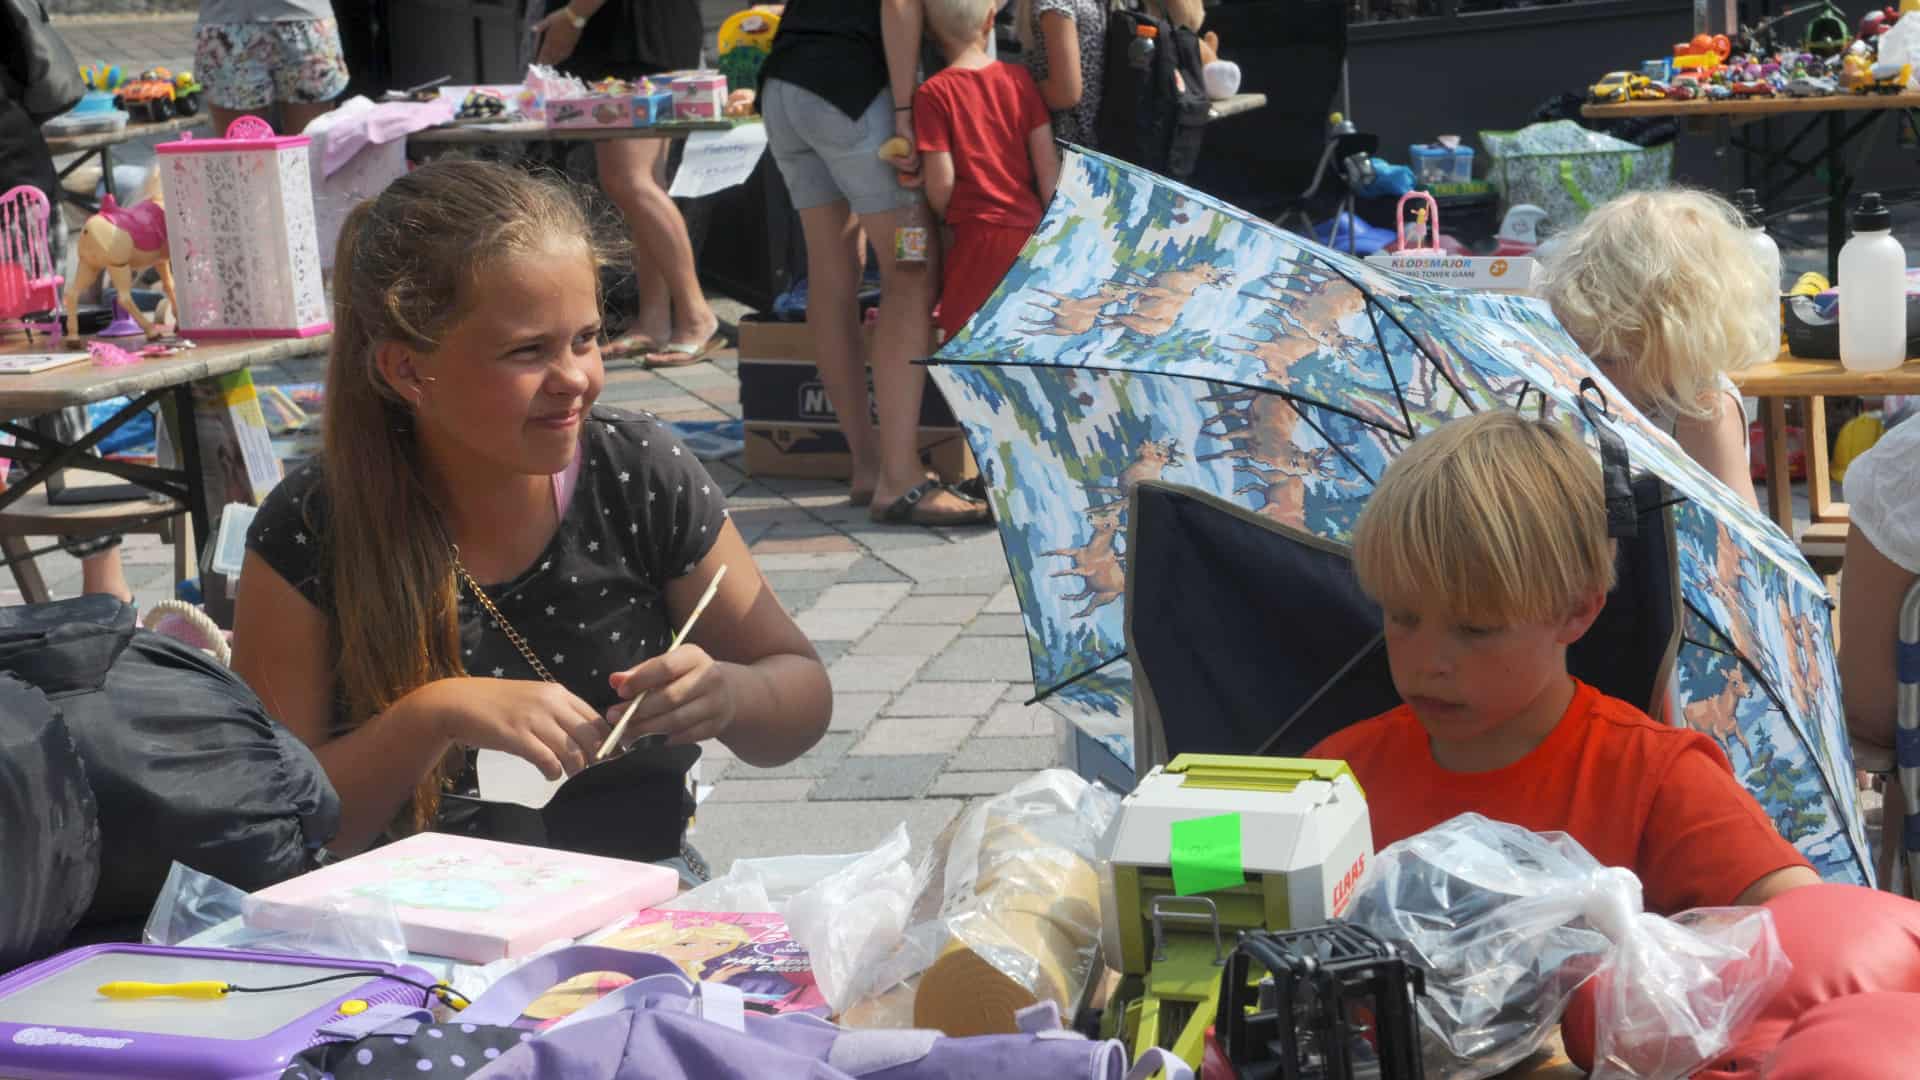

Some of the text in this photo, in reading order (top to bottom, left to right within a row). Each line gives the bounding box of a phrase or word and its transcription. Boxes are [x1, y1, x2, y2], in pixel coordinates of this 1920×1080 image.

[1391, 258, 1473, 269] KLODSMAJOR
[1421, 271, 1450, 279] TOWER
[1451, 271, 1475, 280] GAME
[1332, 852, 1366, 908] CLAAS
